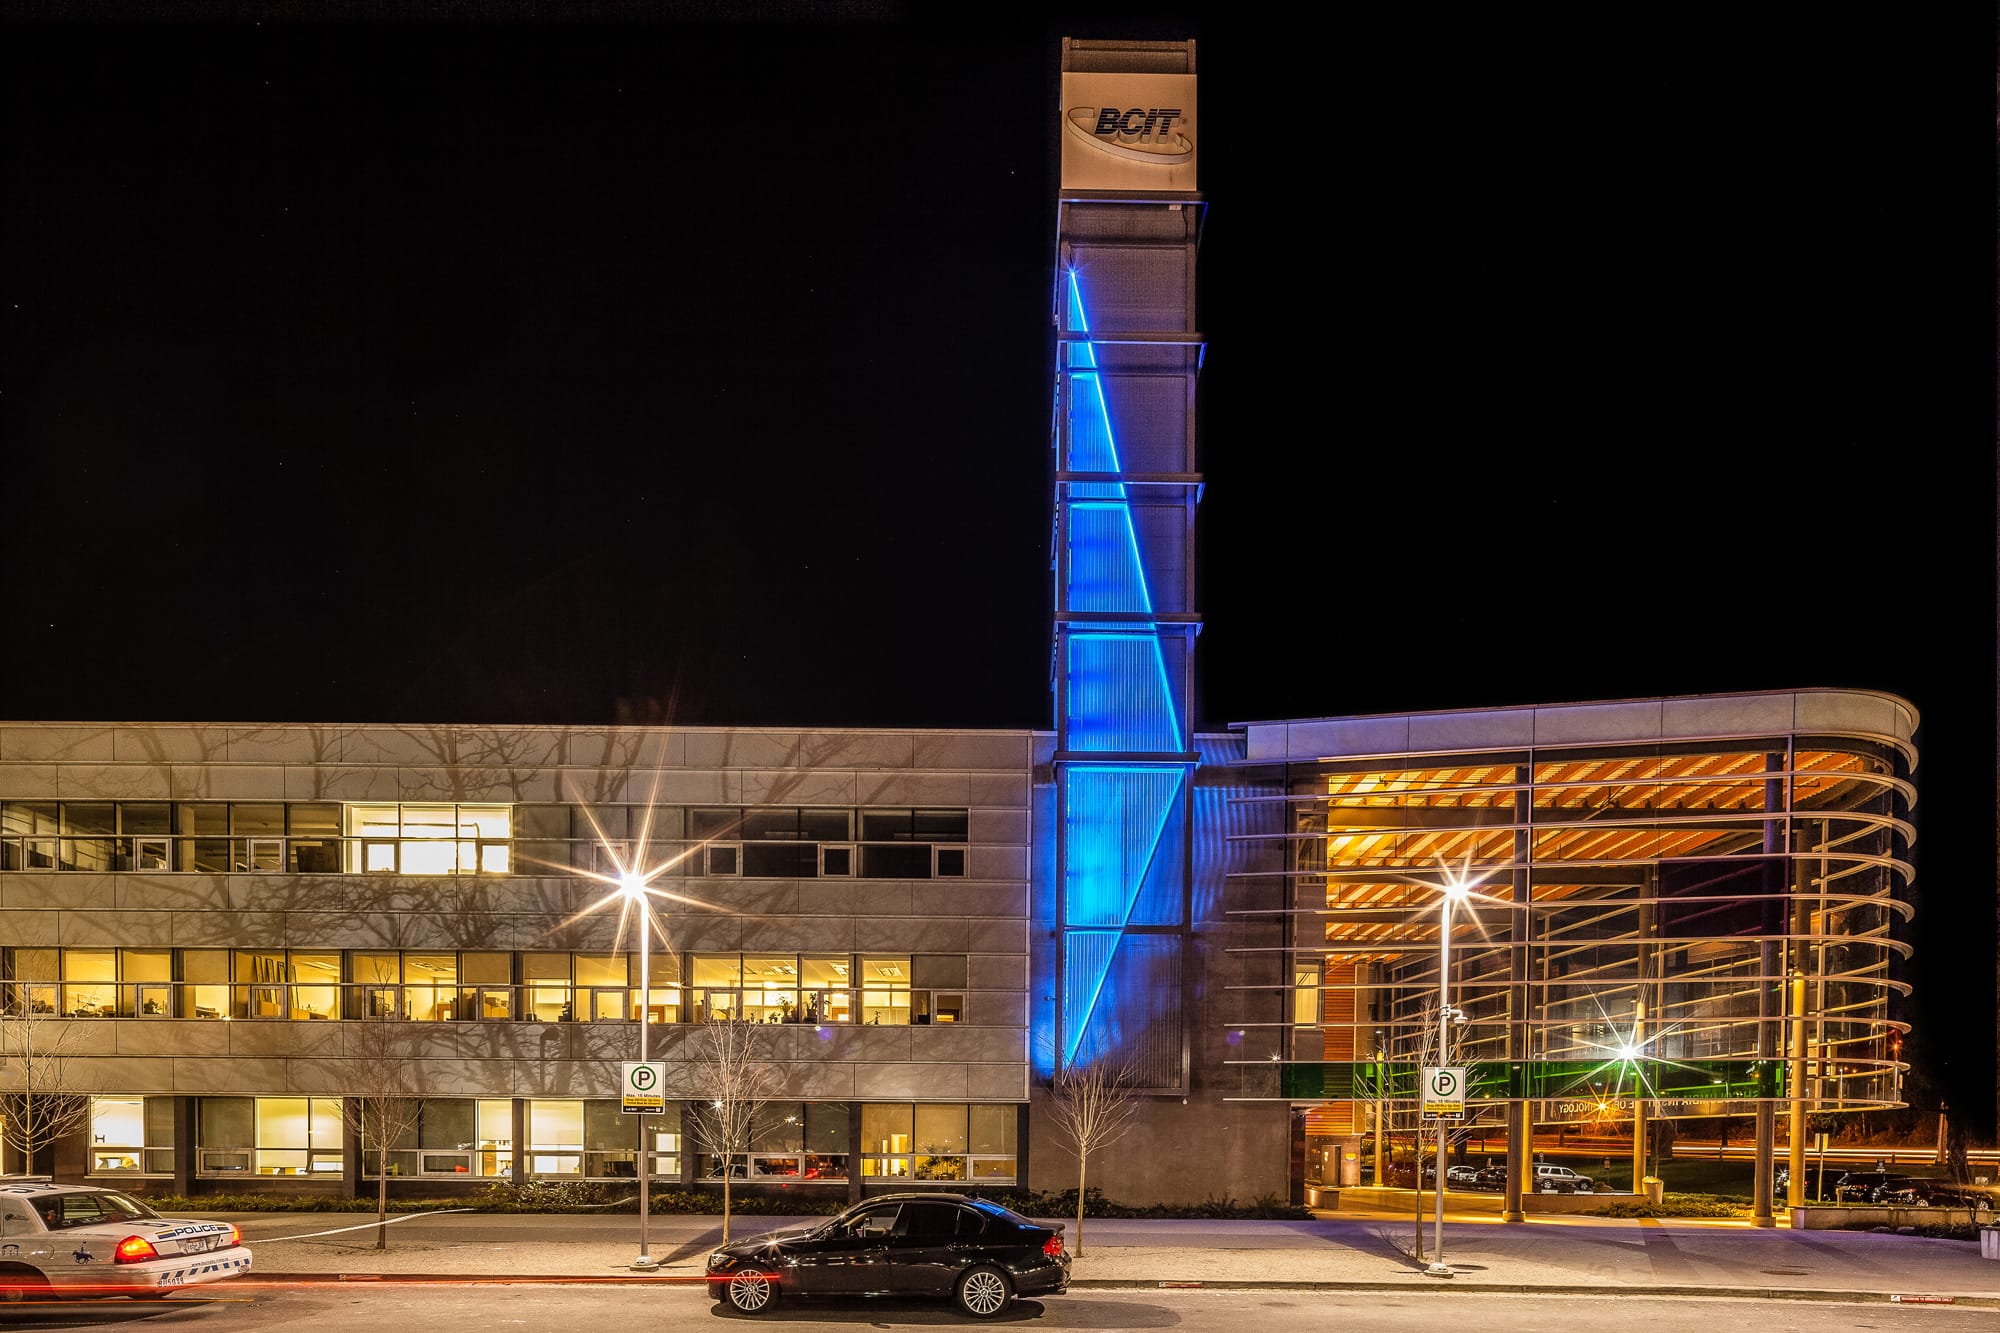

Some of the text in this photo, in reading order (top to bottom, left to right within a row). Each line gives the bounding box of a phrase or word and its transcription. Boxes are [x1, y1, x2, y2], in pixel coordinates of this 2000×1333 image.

[1095, 108, 1181, 136] BCIT
[638, 1071, 651, 1086] P
[1439, 1076, 1451, 1091] P
[175, 1224, 217, 1236] POLICE
